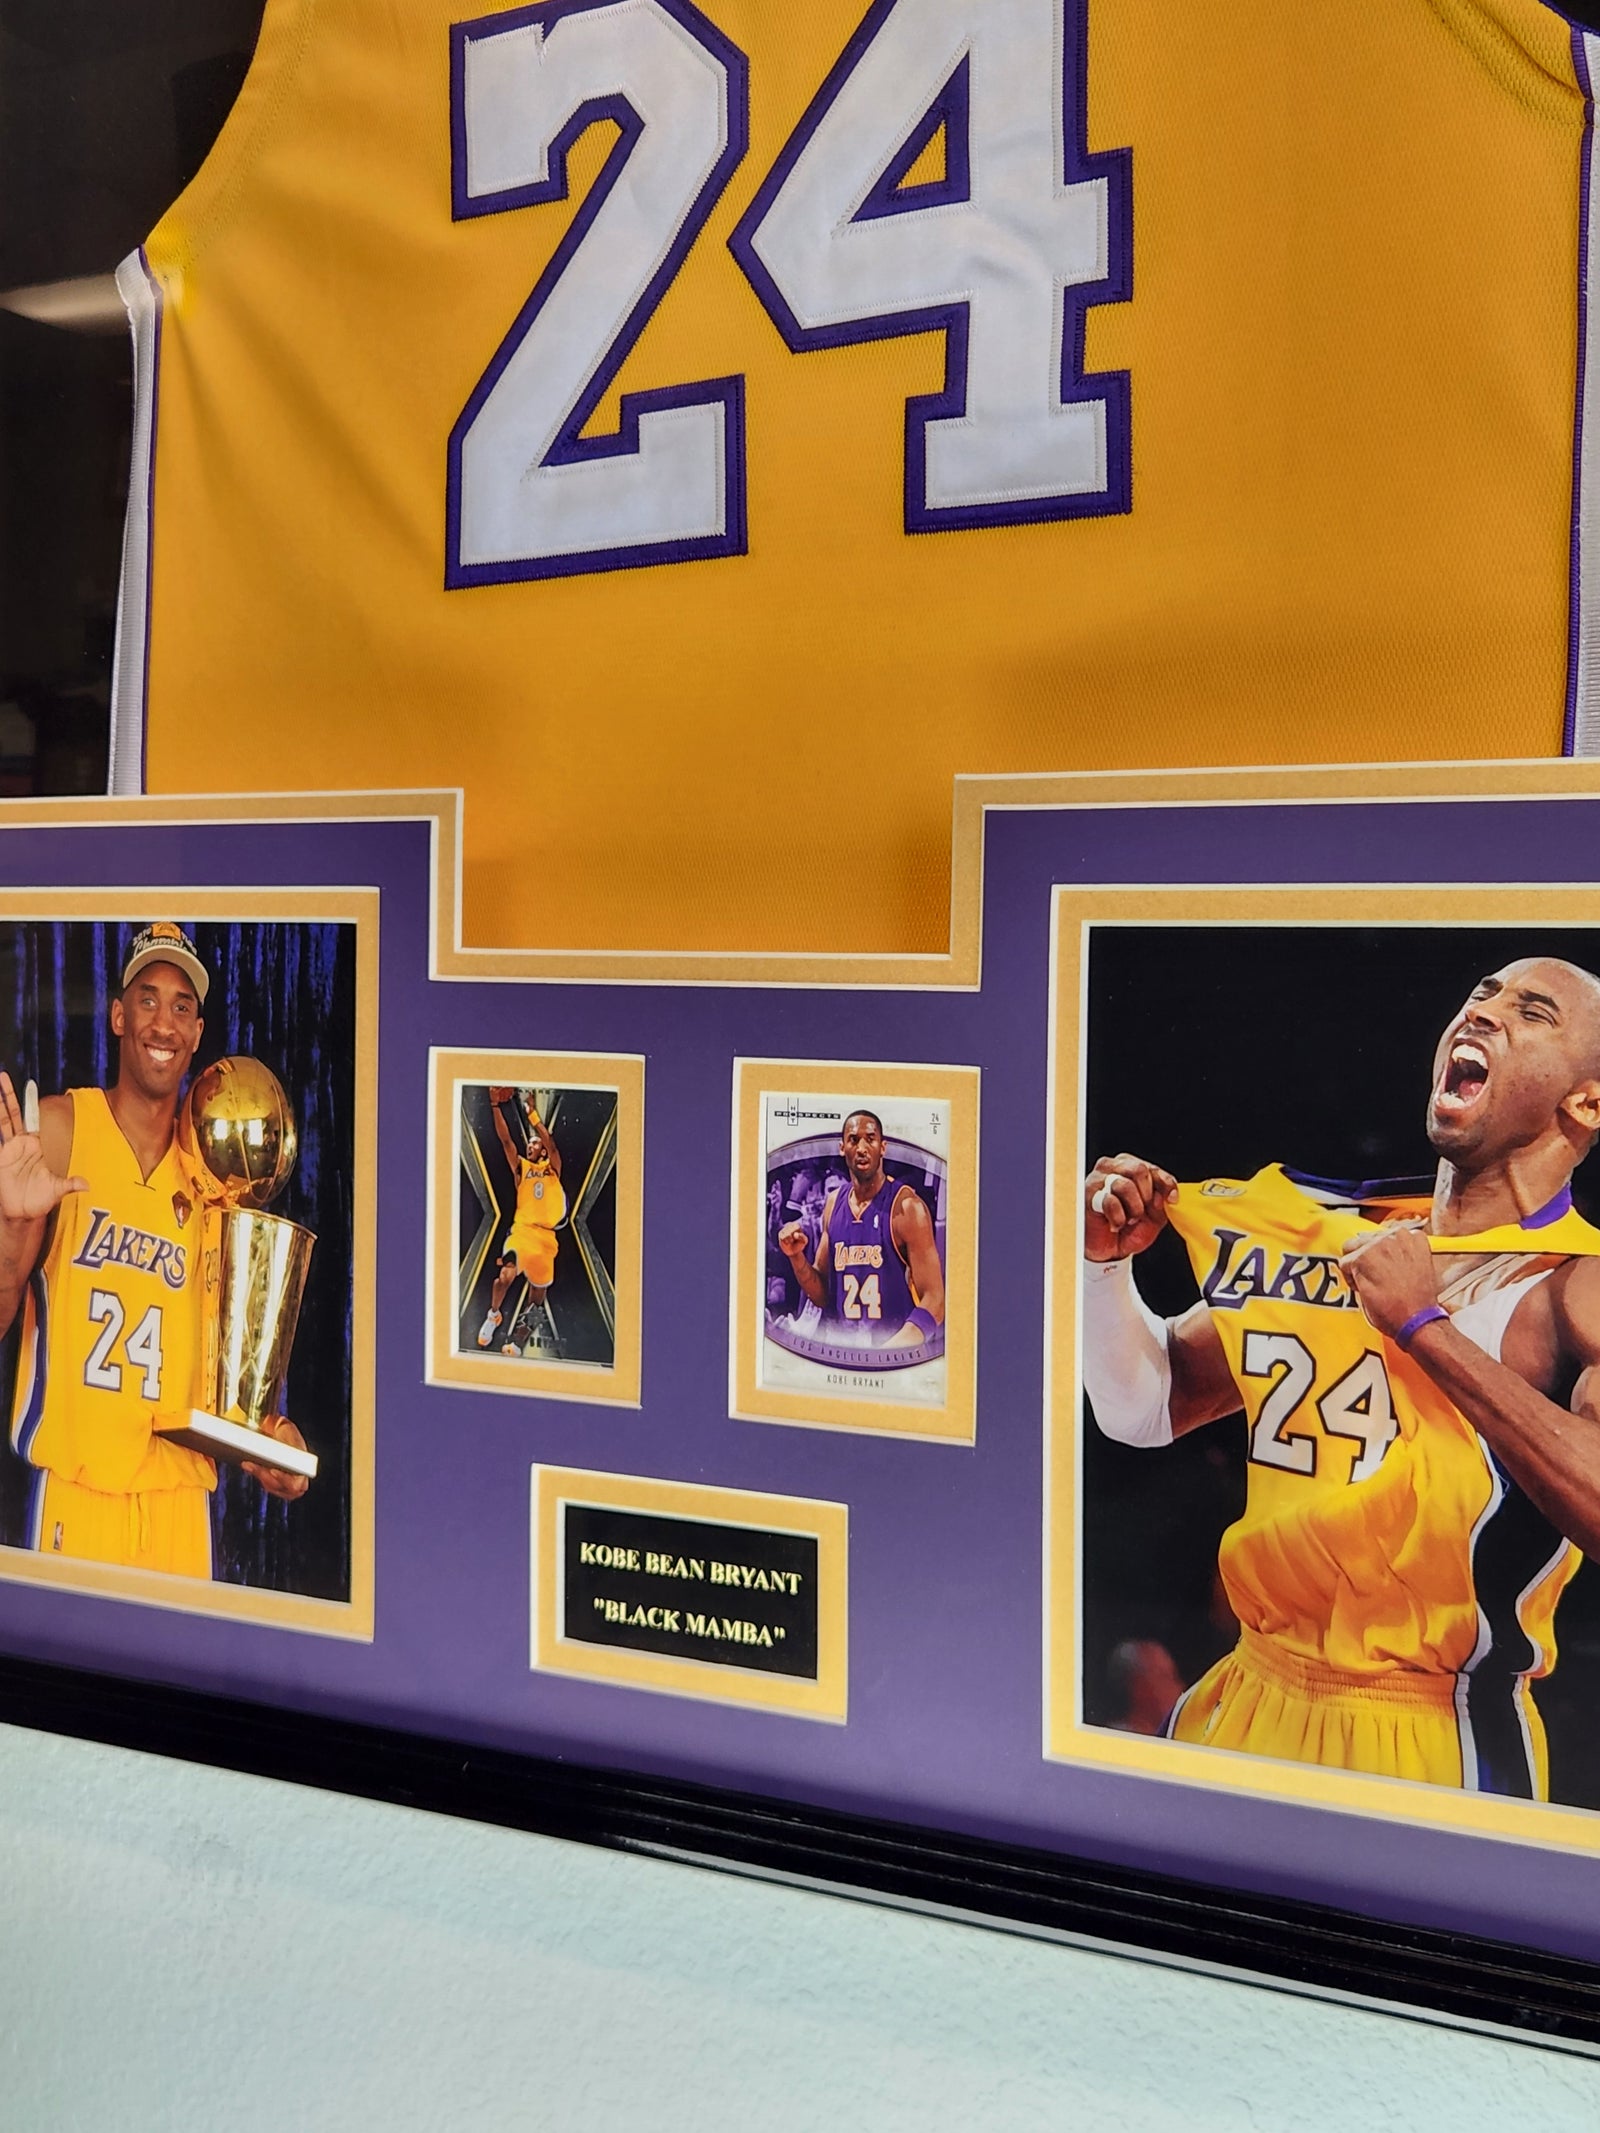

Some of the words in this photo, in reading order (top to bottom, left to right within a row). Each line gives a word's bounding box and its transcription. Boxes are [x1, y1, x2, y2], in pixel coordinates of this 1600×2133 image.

[444, 0, 1133, 590] 24
[534, 1181, 544, 1200] 8
[73, 1208, 187, 1290] LAKERS
[1202, 1227, 1361, 1310] LAKE
[843, 1274, 881, 1319] 24
[83, 1287, 163, 1401] 24
[793, 1338, 812, 1351] LOS
[821, 1346, 869, 1362] ANGELES
[827, 1373, 848, 1385] KOBE
[853, 1376, 885, 1388] BRYANT
[1241, 1329, 1401, 1485] 24
[580, 1542, 640, 1571] KOBE
[645, 1551, 705, 1580] BEAN
[710, 1561, 802, 1595] BRYANT
[593, 1597, 681, 1632] "BLACK
[684, 1612, 786, 1648] MAMBA"
